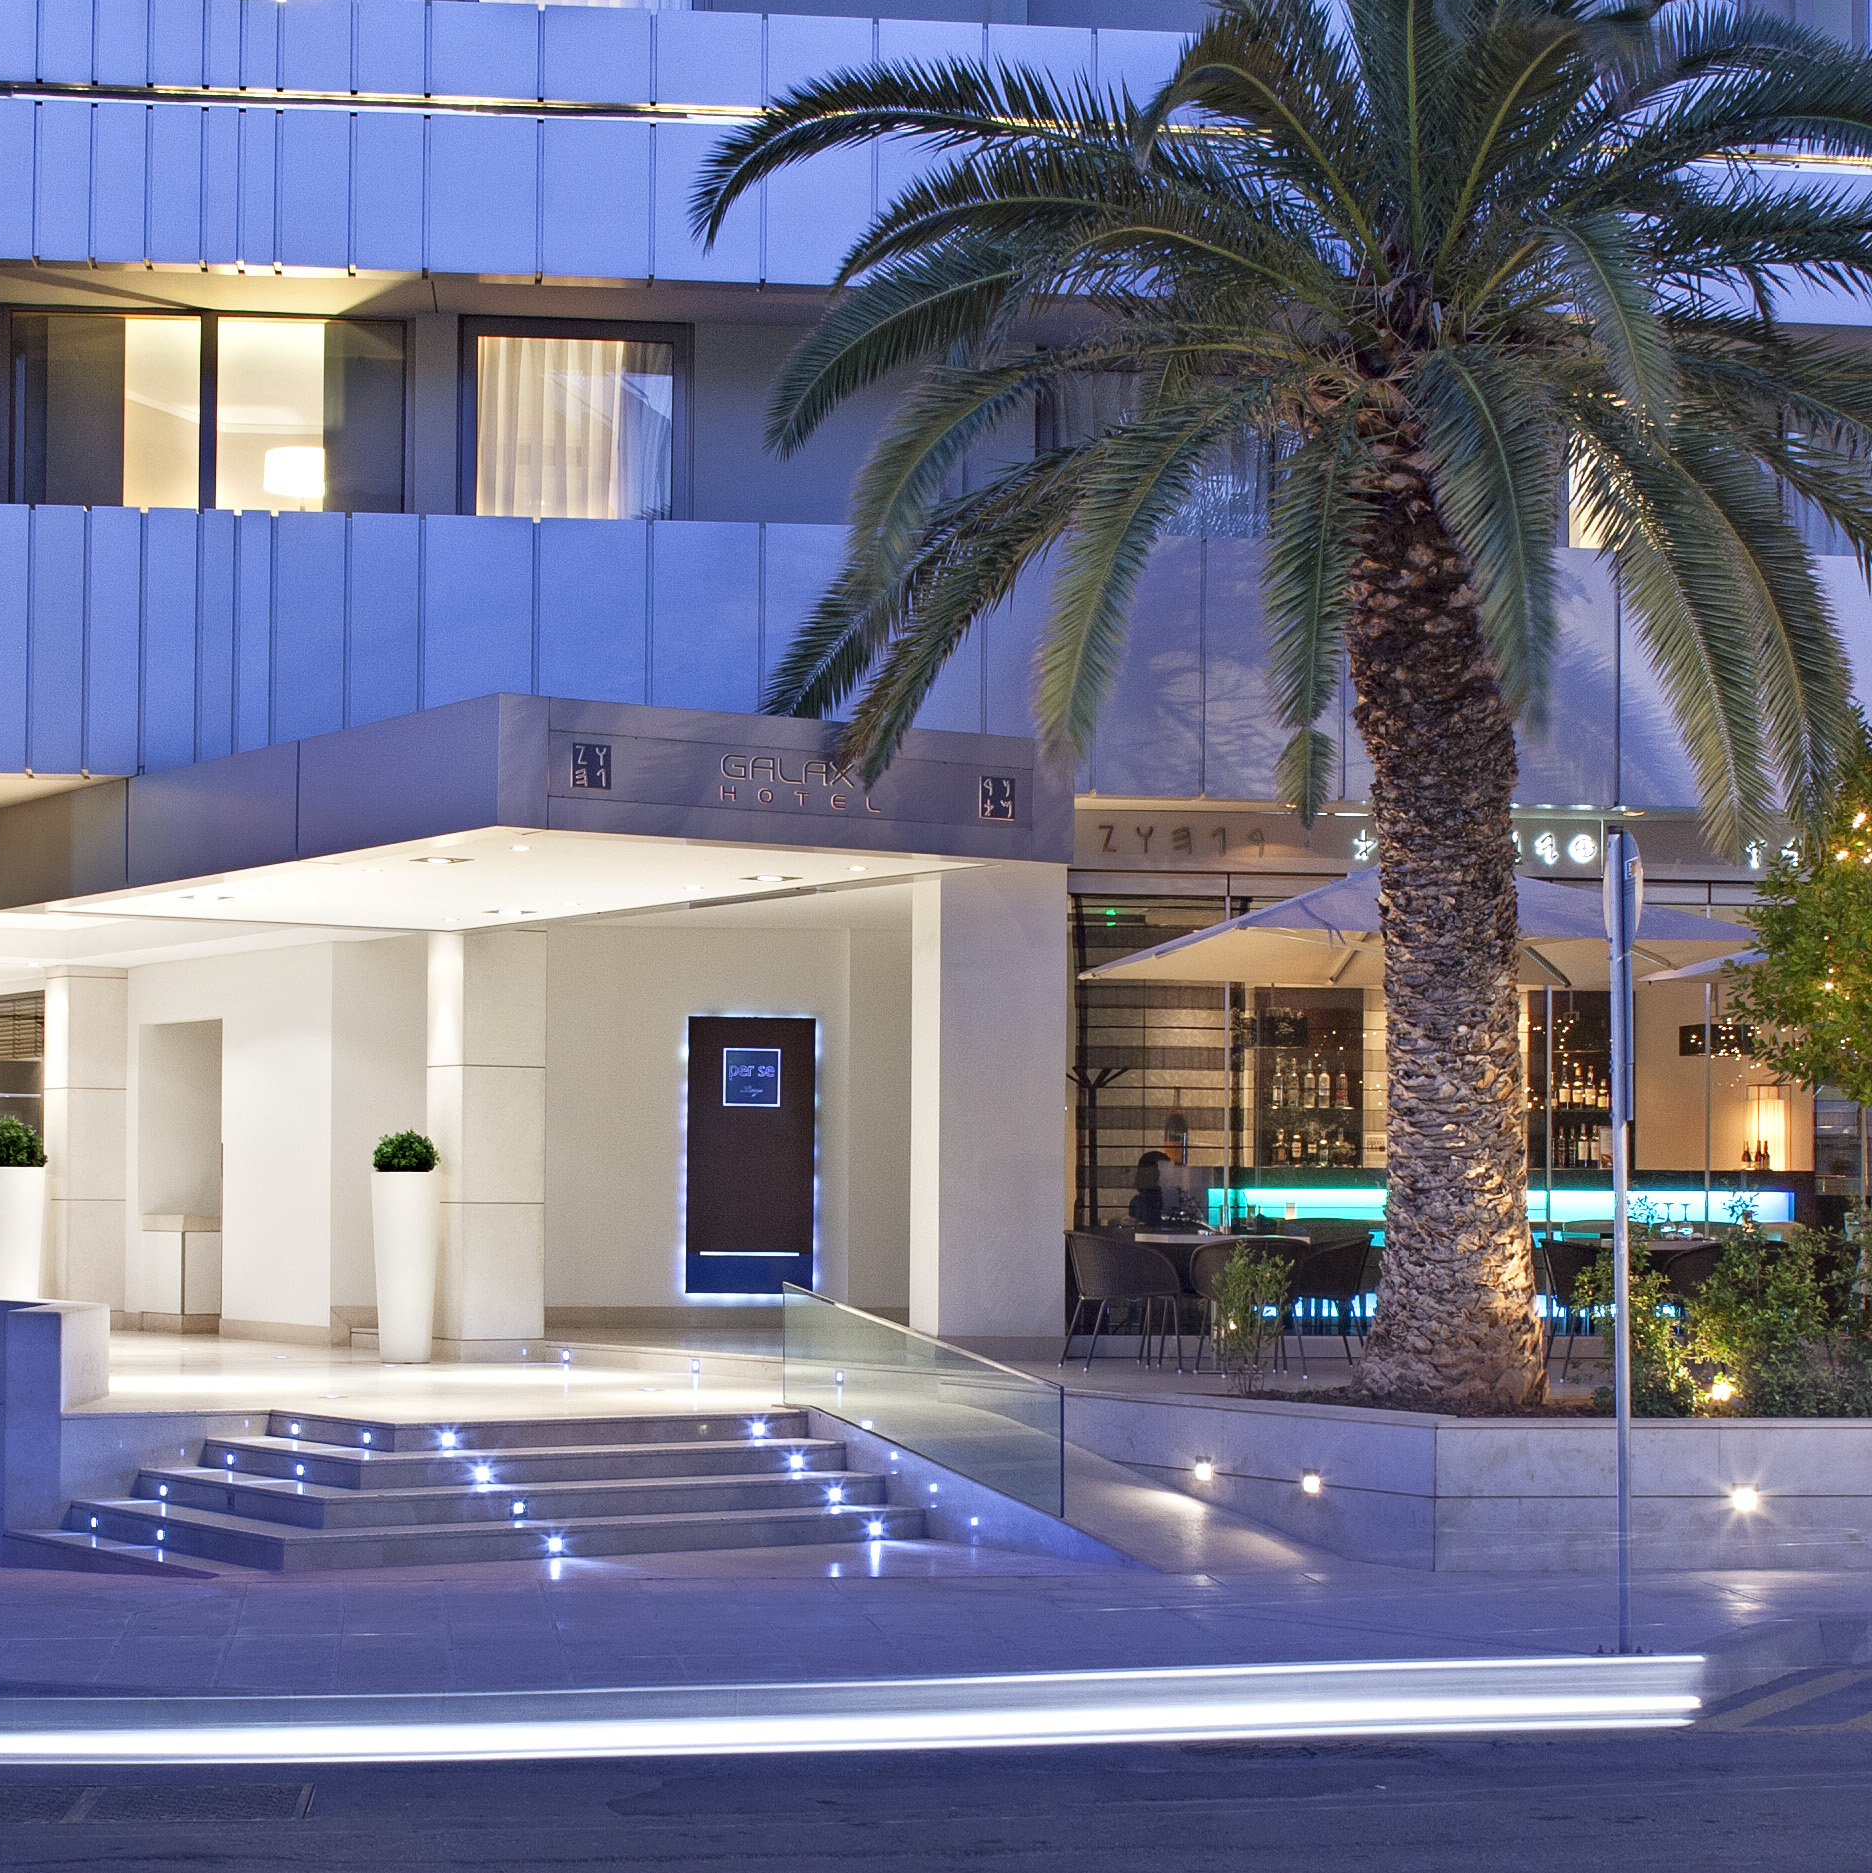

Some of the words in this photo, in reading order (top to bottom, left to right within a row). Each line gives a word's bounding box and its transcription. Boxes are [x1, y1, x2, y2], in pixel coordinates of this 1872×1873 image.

[720, 753, 857, 789] GALAX
[720, 785, 882, 814] HOTEL
[728, 1064, 755, 1081] per
[757, 1065, 776, 1078] se
